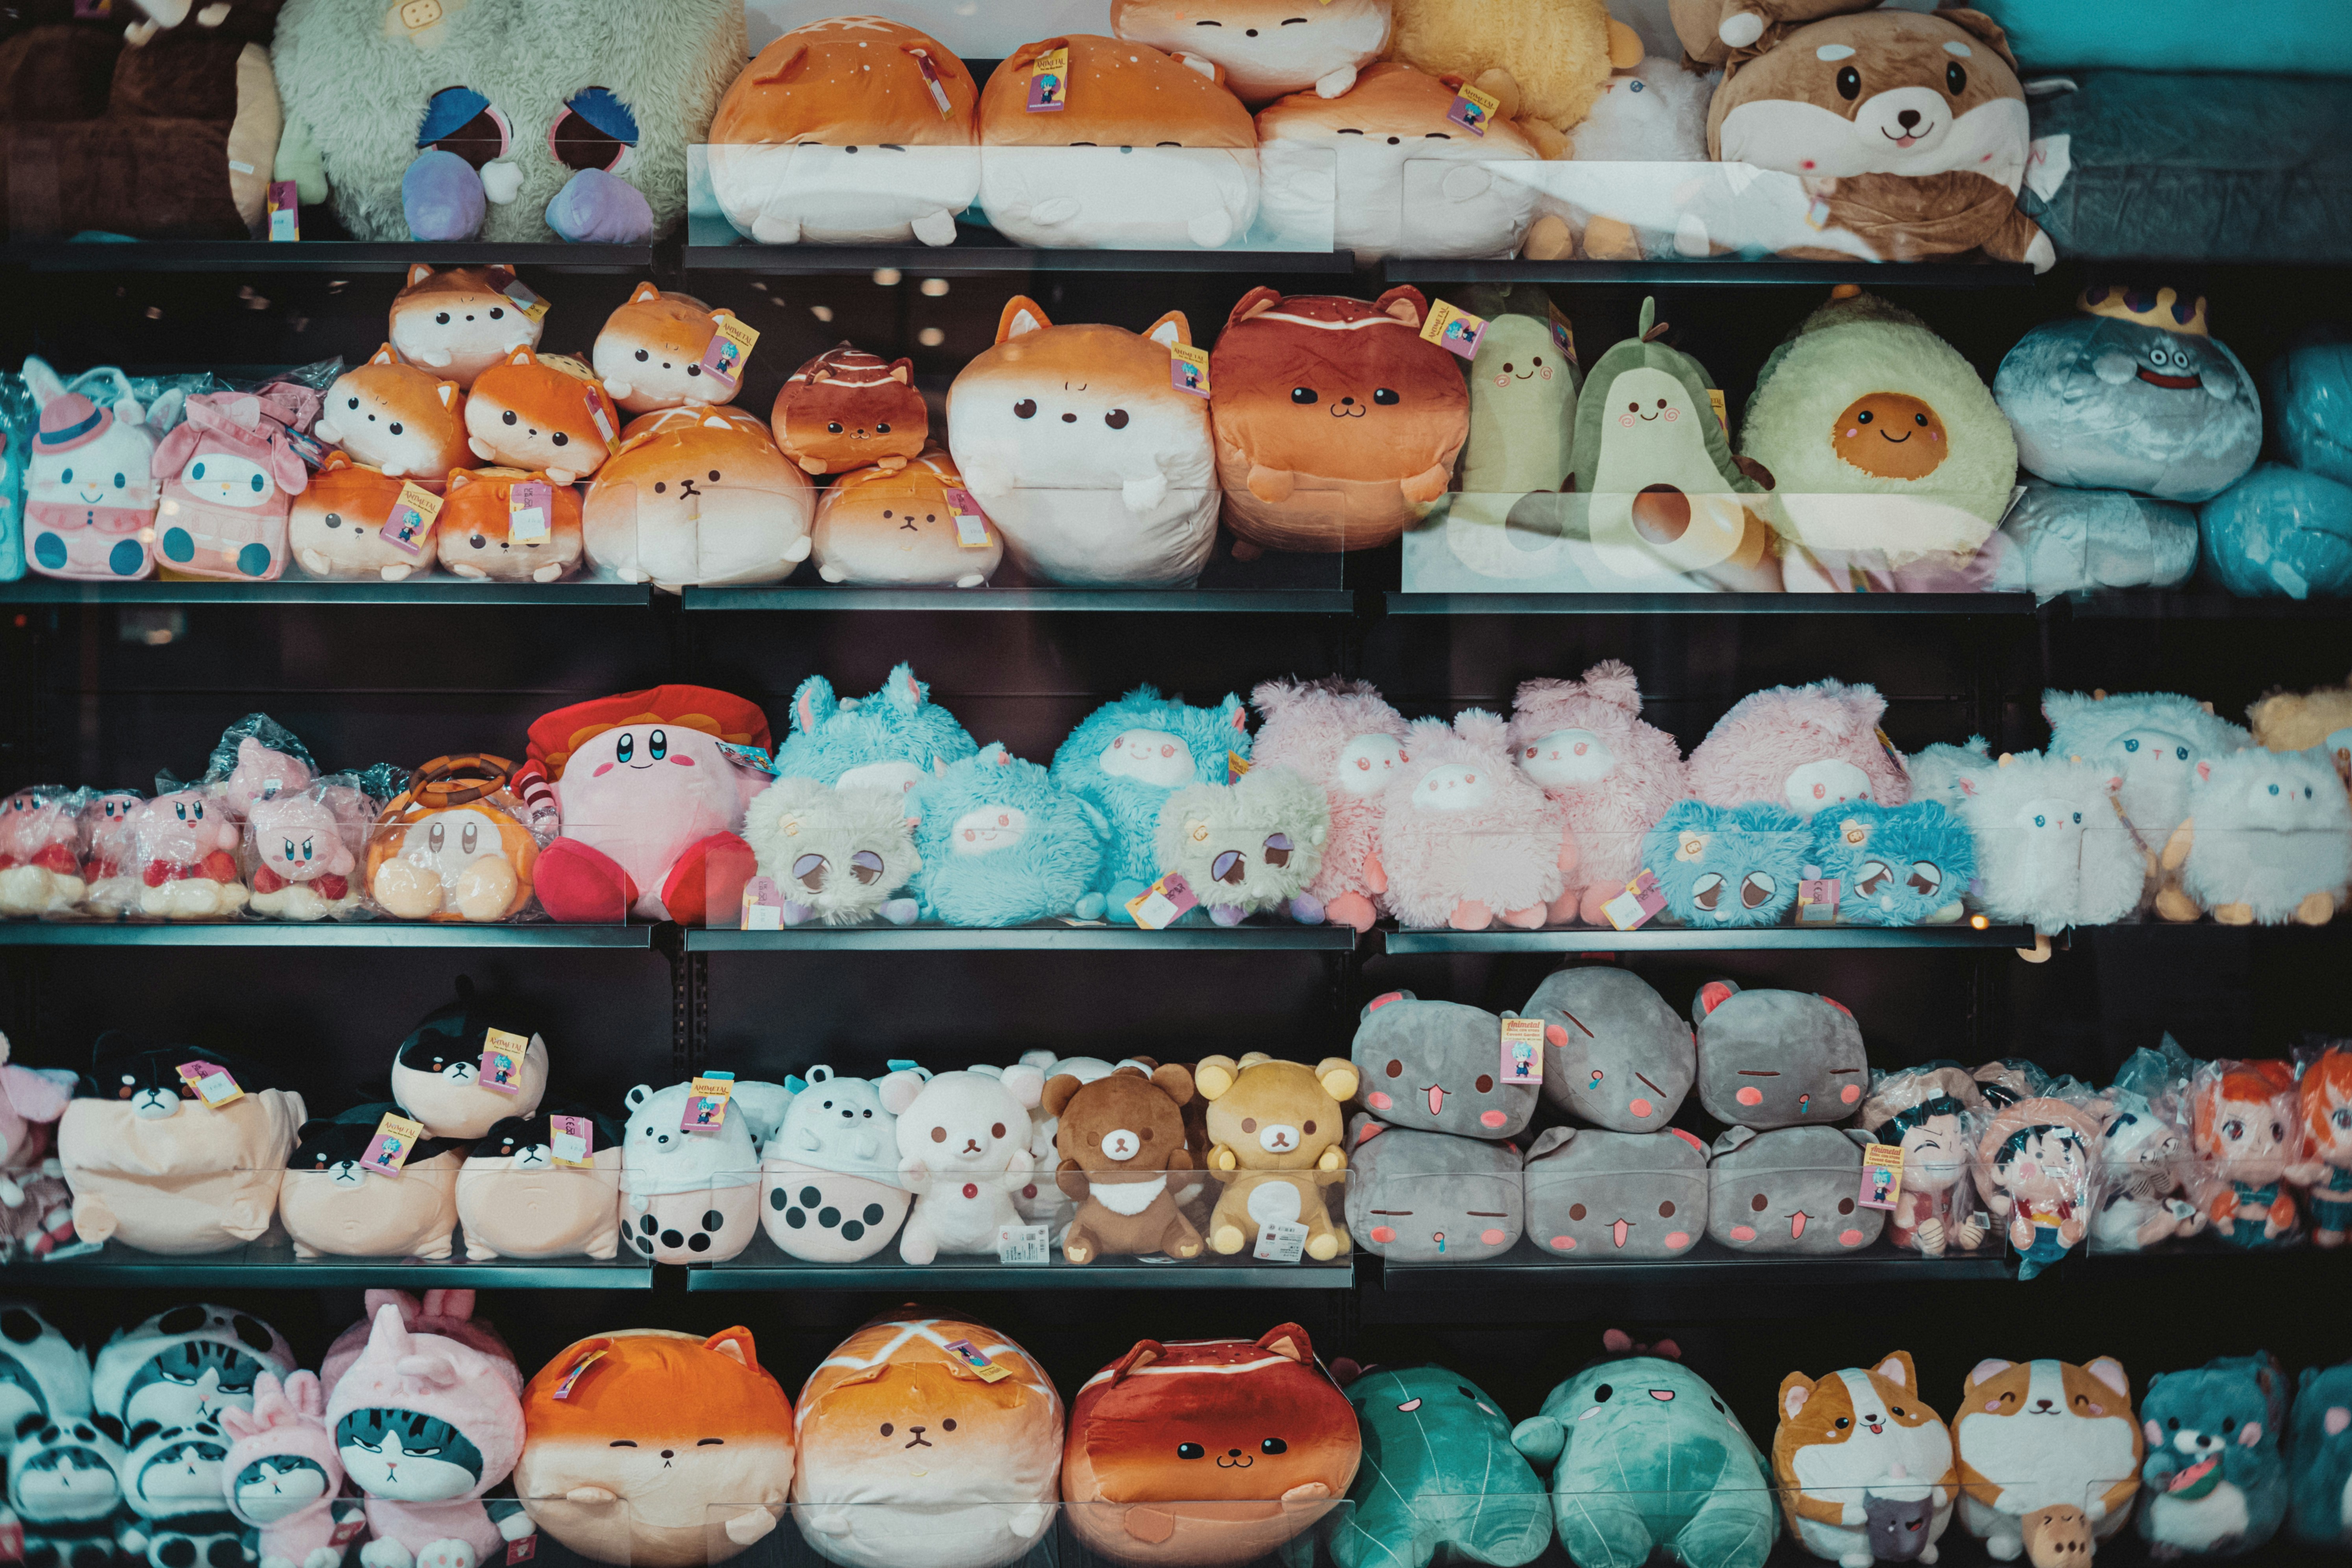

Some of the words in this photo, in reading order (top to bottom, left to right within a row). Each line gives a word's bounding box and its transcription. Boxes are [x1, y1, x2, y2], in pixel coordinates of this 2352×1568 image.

[1035, 58, 1065, 68] ANIMETAL
[1464, 88, 1495, 109] ANIMETAL
[1428, 305, 1449, 339] ANIMETAL
[723, 323, 753, 346] ANIMETAL
[405, 490, 438, 512] ANIMETAL
[490, 1037, 523, 1052] ANIMETAL
[695, 1085, 729, 1093] ANIMETAL
[385, 1121, 416, 1138] ANIMETAL
[566, 1117, 575, 1126] CE
[1871, 1145, 1901, 1156] Animetal
